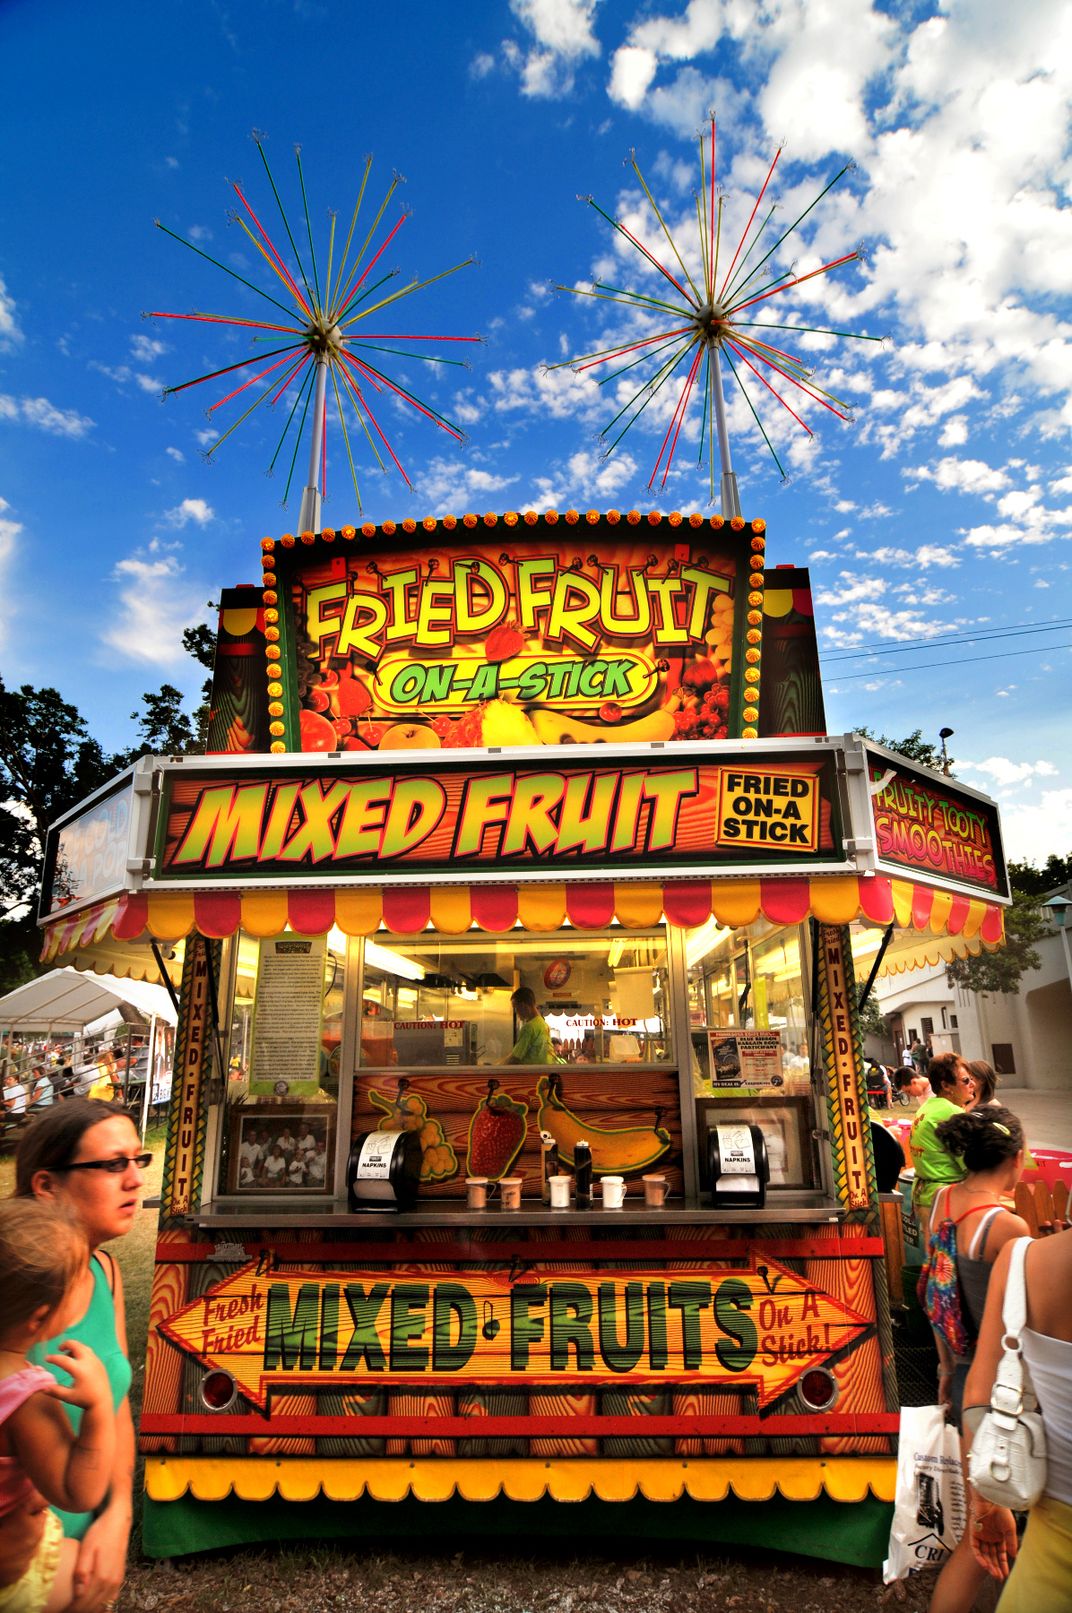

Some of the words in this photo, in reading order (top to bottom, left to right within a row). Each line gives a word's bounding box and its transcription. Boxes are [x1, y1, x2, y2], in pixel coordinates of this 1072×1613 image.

[305, 559, 506, 660] FRIED
[520, 559, 731, 652] FRUIT
[392, 658, 638, 703] ON-A-STICK
[727, 774, 809, 798] FRIED
[732, 796, 801, 820] ON-A
[874, 772, 935, 824] FRUITY
[939, 801, 986, 844] TOOTY
[171, 775, 447, 869] MIXED
[454, 767, 699, 858] FRUIT
[723, 818, 809, 844] STICK
[875, 816, 996, 884] SMOOTHIES
[189, 961, 206, 1066] MIXED
[440, 1021, 464, 1029] HOT
[566, 1019, 609, 1027] CAUTION:
[613, 1018, 637, 1026] HOT
[828, 947, 849, 1055] MIXED
[842, 1074, 861, 1190] FRUIT
[178, 1084, 195, 1196] FRUIT
[203, 1284, 264, 1326] Fresh
[264, 1282, 478, 1372] MIXED
[510, 1278, 758, 1373] FRUITS
[758, 1299, 793, 1331] On
[801, 1288, 820, 1321] A
[201, 1315, 262, 1359] Fried
[761, 1323, 831, 1367] Stick!
[914, 1544, 945, 1561] CRI
